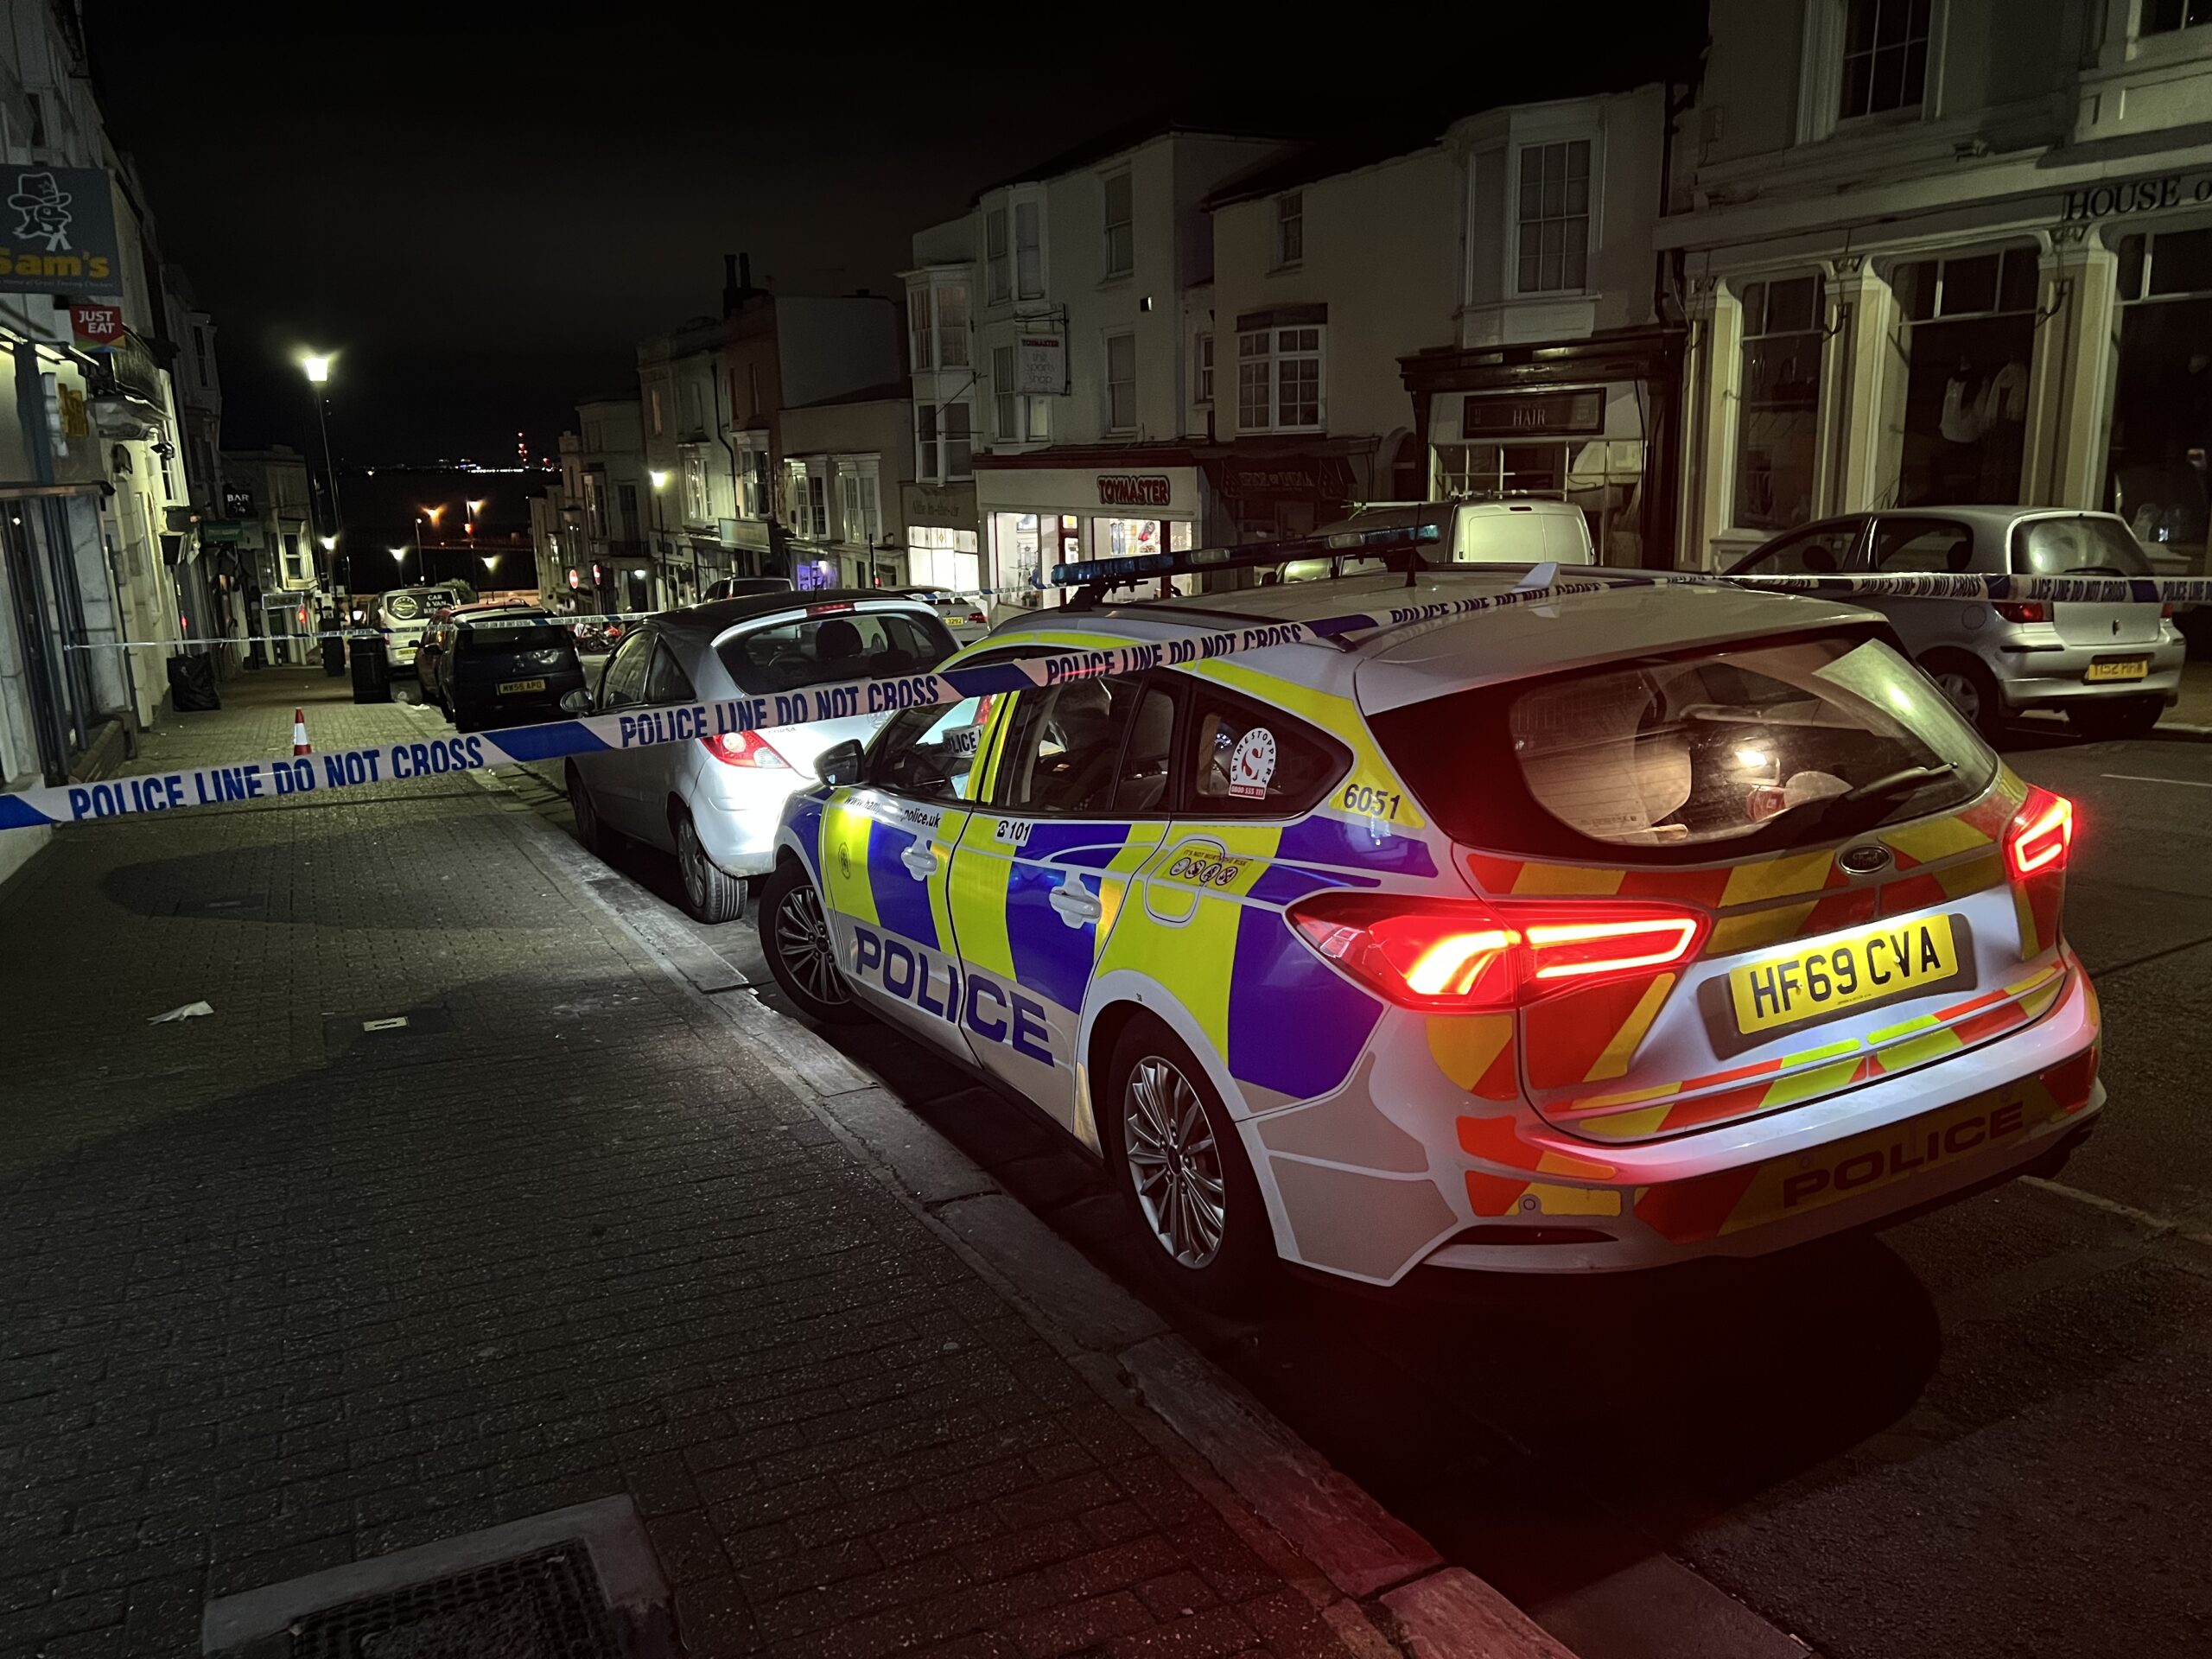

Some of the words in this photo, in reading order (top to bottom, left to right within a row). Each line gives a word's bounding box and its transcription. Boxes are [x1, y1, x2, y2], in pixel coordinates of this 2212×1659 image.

[2063, 175, 2181, 220] HOUSE
[79, 310, 113, 323] JUST
[87, 323, 115, 334] EAT
[1513, 408, 1547, 427] HAIR
[1097, 475, 1170, 505] TOYMASTER
[1046, 651, 1115, 686] POLICE
[1122, 644, 1163, 671] LINE
[1168, 639, 1196, 665] DO
[1201, 633, 1236, 658] NOT
[1243, 623, 1302, 651] CROSS
[620, 706, 709, 748] POLICE
[715, 698, 767, 734] LINE
[774, 692, 808, 726] DO
[816, 687, 860, 718] NOT
[868, 676, 939, 712] CROSS
[68, 775, 187, 821] POLICE
[194, 765, 264, 804] LINE
[272, 759, 315, 795] DO
[324, 749, 380, 788] NOT
[391, 735, 484, 779] CROSS
[1231, 730, 1274, 785] CRIMESTOPPERS
[1344, 784, 1401, 820] 6051
[1009, 822, 1032, 842] 101
[855, 925, 1055, 1068] POLICE
[1750, 948, 1857, 1019] HF69
[1866, 926, 1942, 986] CVA
[1783, 1101, 2024, 1209] POLICE
